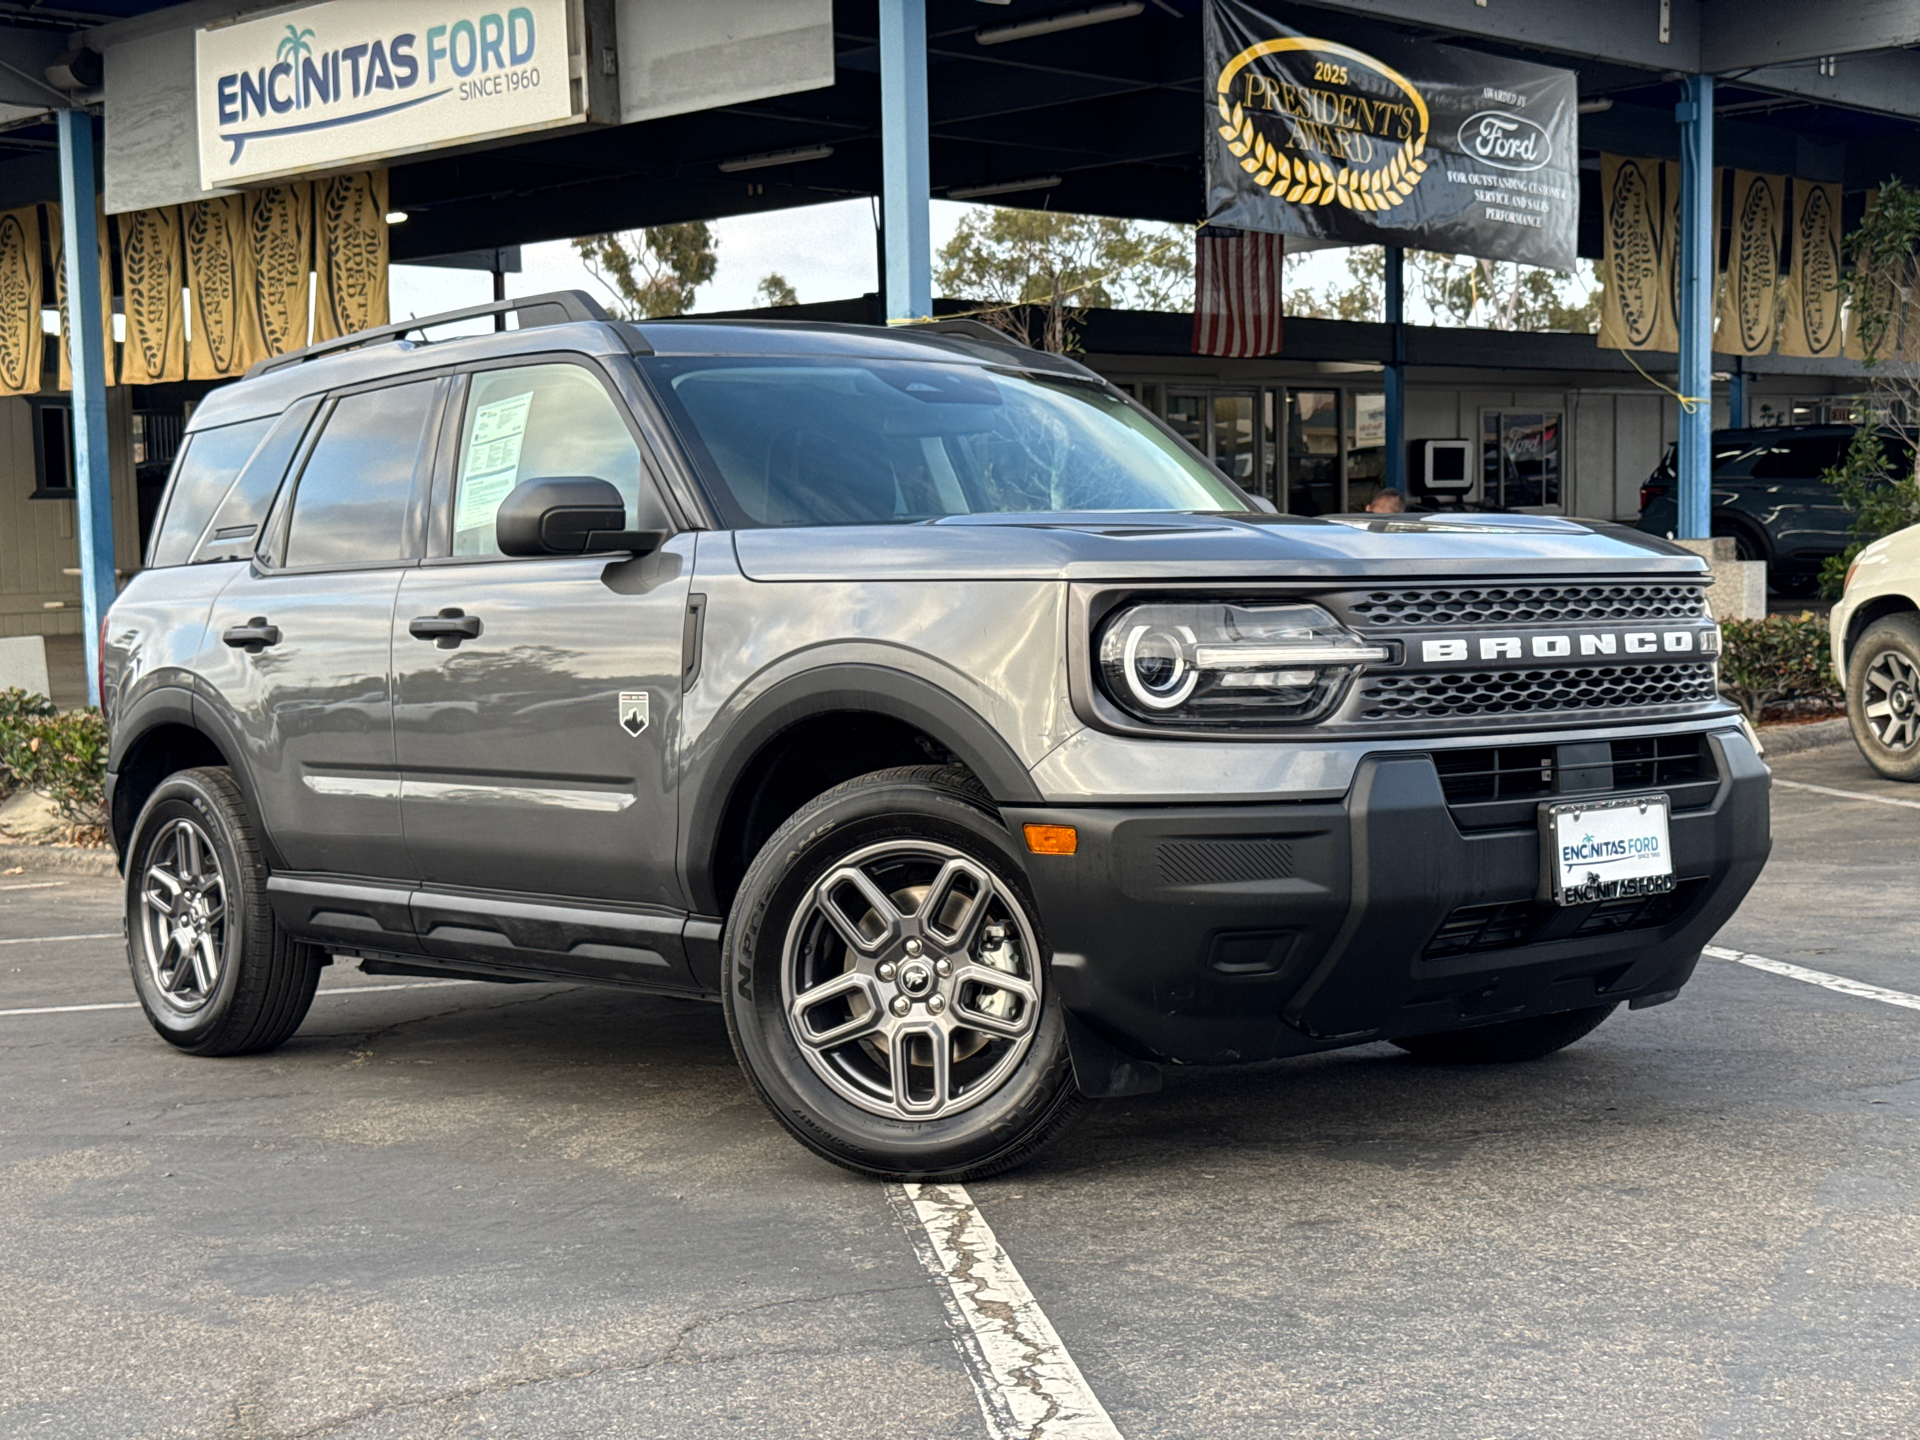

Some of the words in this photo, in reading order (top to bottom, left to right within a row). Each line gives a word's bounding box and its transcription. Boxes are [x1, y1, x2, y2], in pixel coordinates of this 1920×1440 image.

[218, 30, 418, 126] ENCINITAS
[427, 7, 536, 83] FORD
[459, 78, 502, 101] SINCE
[504, 68, 541, 92] 1960
[1313, 61, 1348, 85] 2025
[1244, 72, 1414, 139] PRESIDENT'S
[1482, 87, 1517, 106] AWARDED
[1517, 95, 1527, 108] BY
[1285, 117, 1373, 164] AWARD
[1475, 117, 1537, 160] Ford
[1447, 170, 1467, 184] FOR
[1468, 172, 1527, 192] OUTSTANDING
[1474, 189, 1509, 205] SERVICE
[1512, 196, 1525, 209] AND
[1528, 198, 1549, 213] SALES
[1486, 207, 1541, 228] PERFORMANCE
[267, 231, 280, 306] AWARD
[286, 239, 299, 288] 2021
[343, 220, 358, 299] AWARD
[352, 187, 369, 334] PRESIDENT'S
[361, 229, 379, 282] 2022
[1639, 233, 1654, 279] 2016
[147, 251, 158, 324] AWARD
[1830, 408, 1848, 420] EXIT
[1505, 427, 1541, 453] Ford
[1422, 631, 1693, 662] BRONCO
[1563, 837, 1626, 861] ENCINITAS
[1628, 836, 1659, 854] FORD
[1564, 876, 1637, 904] ENCINITAS
[1639, 874, 1673, 894] FORD
